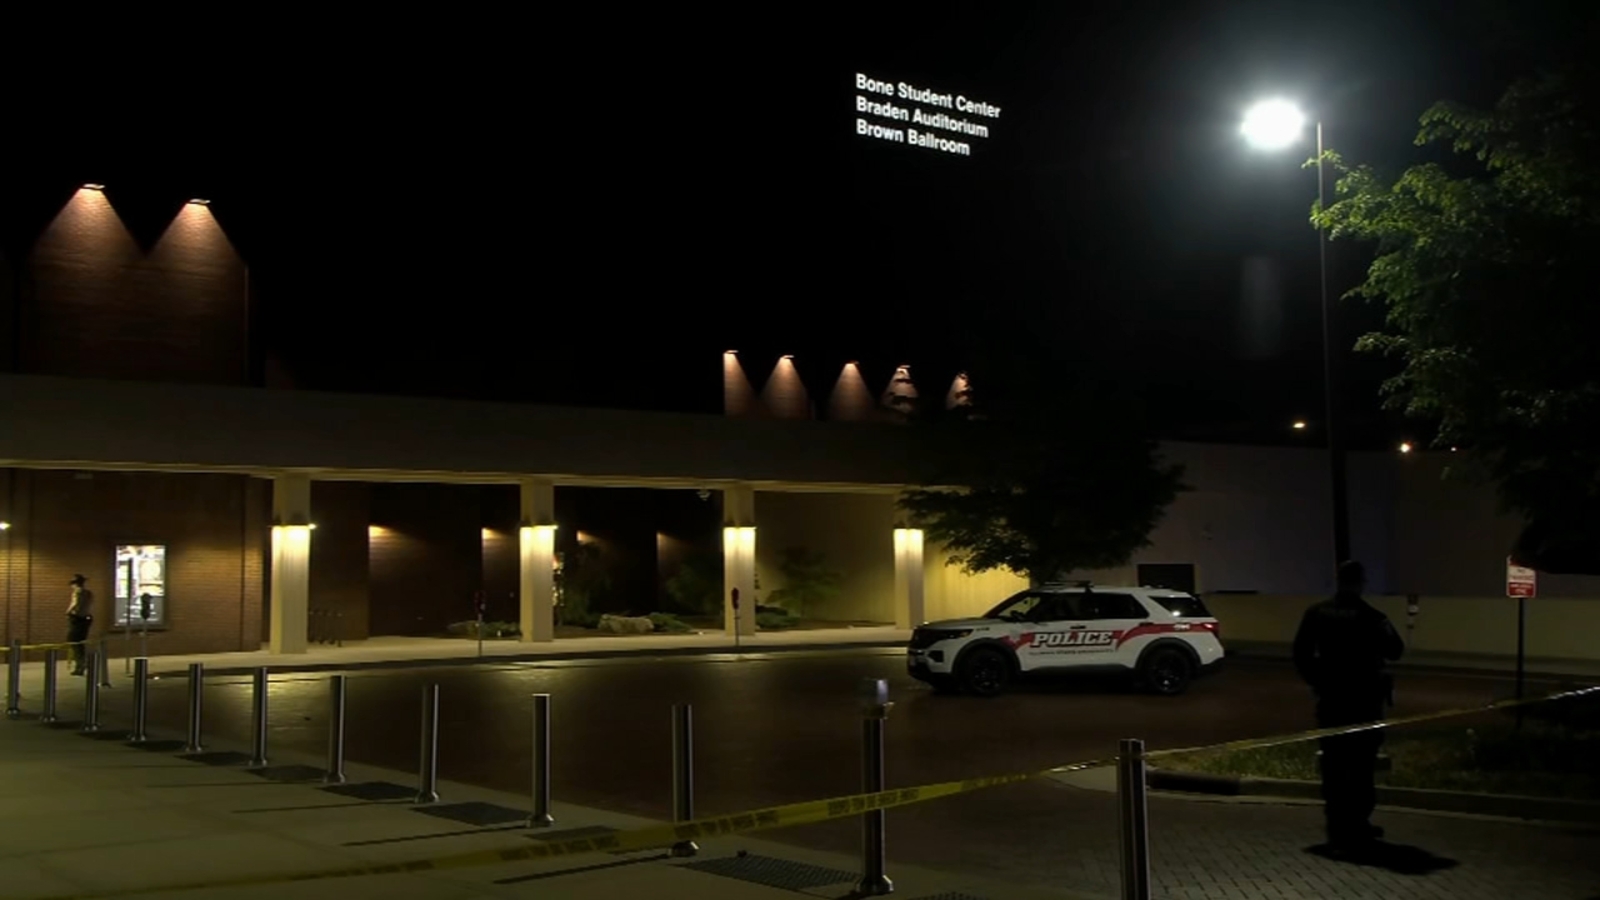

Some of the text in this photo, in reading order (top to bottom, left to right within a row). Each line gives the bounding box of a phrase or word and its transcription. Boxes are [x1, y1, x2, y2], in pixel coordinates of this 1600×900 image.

[856, 73, 1001, 118] Bone Student Center
[856, 95, 989, 138] Braden Auditorium
[856, 118, 970, 156] Brown Ballroom
[1030, 631, 1113, 648] POLICE
